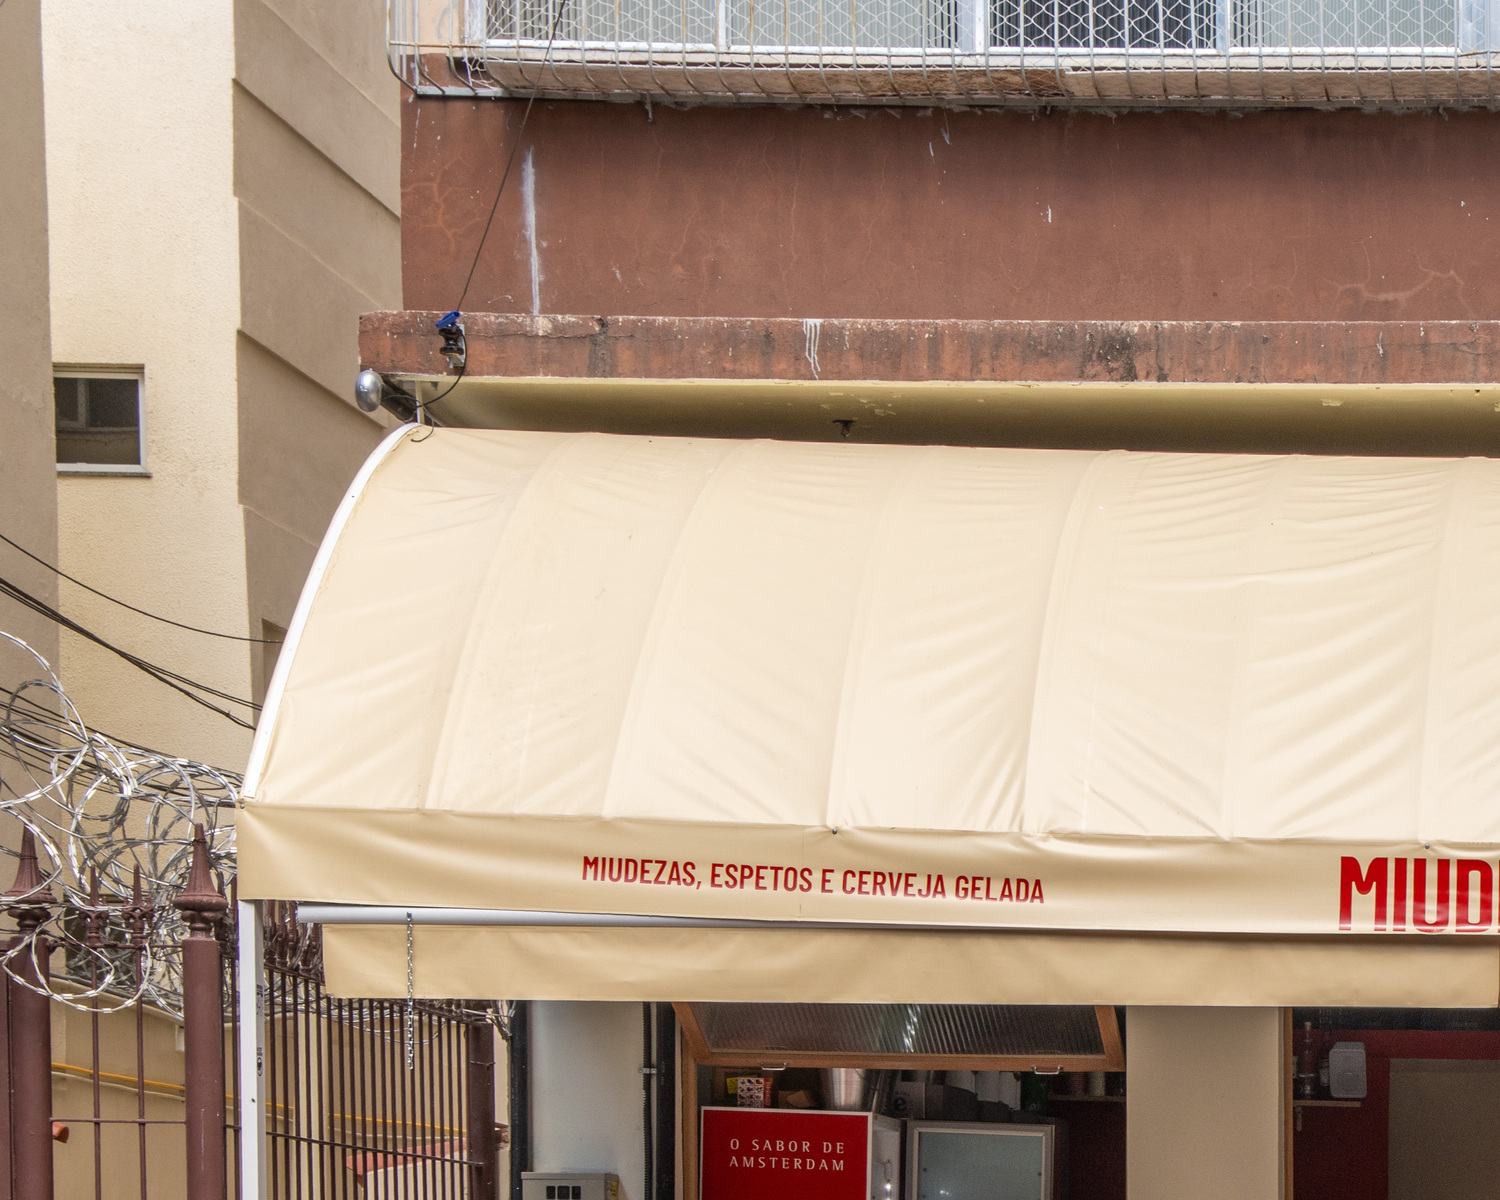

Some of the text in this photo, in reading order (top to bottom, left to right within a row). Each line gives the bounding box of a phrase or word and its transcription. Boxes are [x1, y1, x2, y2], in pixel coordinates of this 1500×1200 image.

[582, 856, 1045, 904] MIUDEZAS, ESPETOS E CERVEJA GELADA
[730, 1138, 845, 1154] O SABOR DE
[729, 1156, 845, 1171] AMSTERDAM
